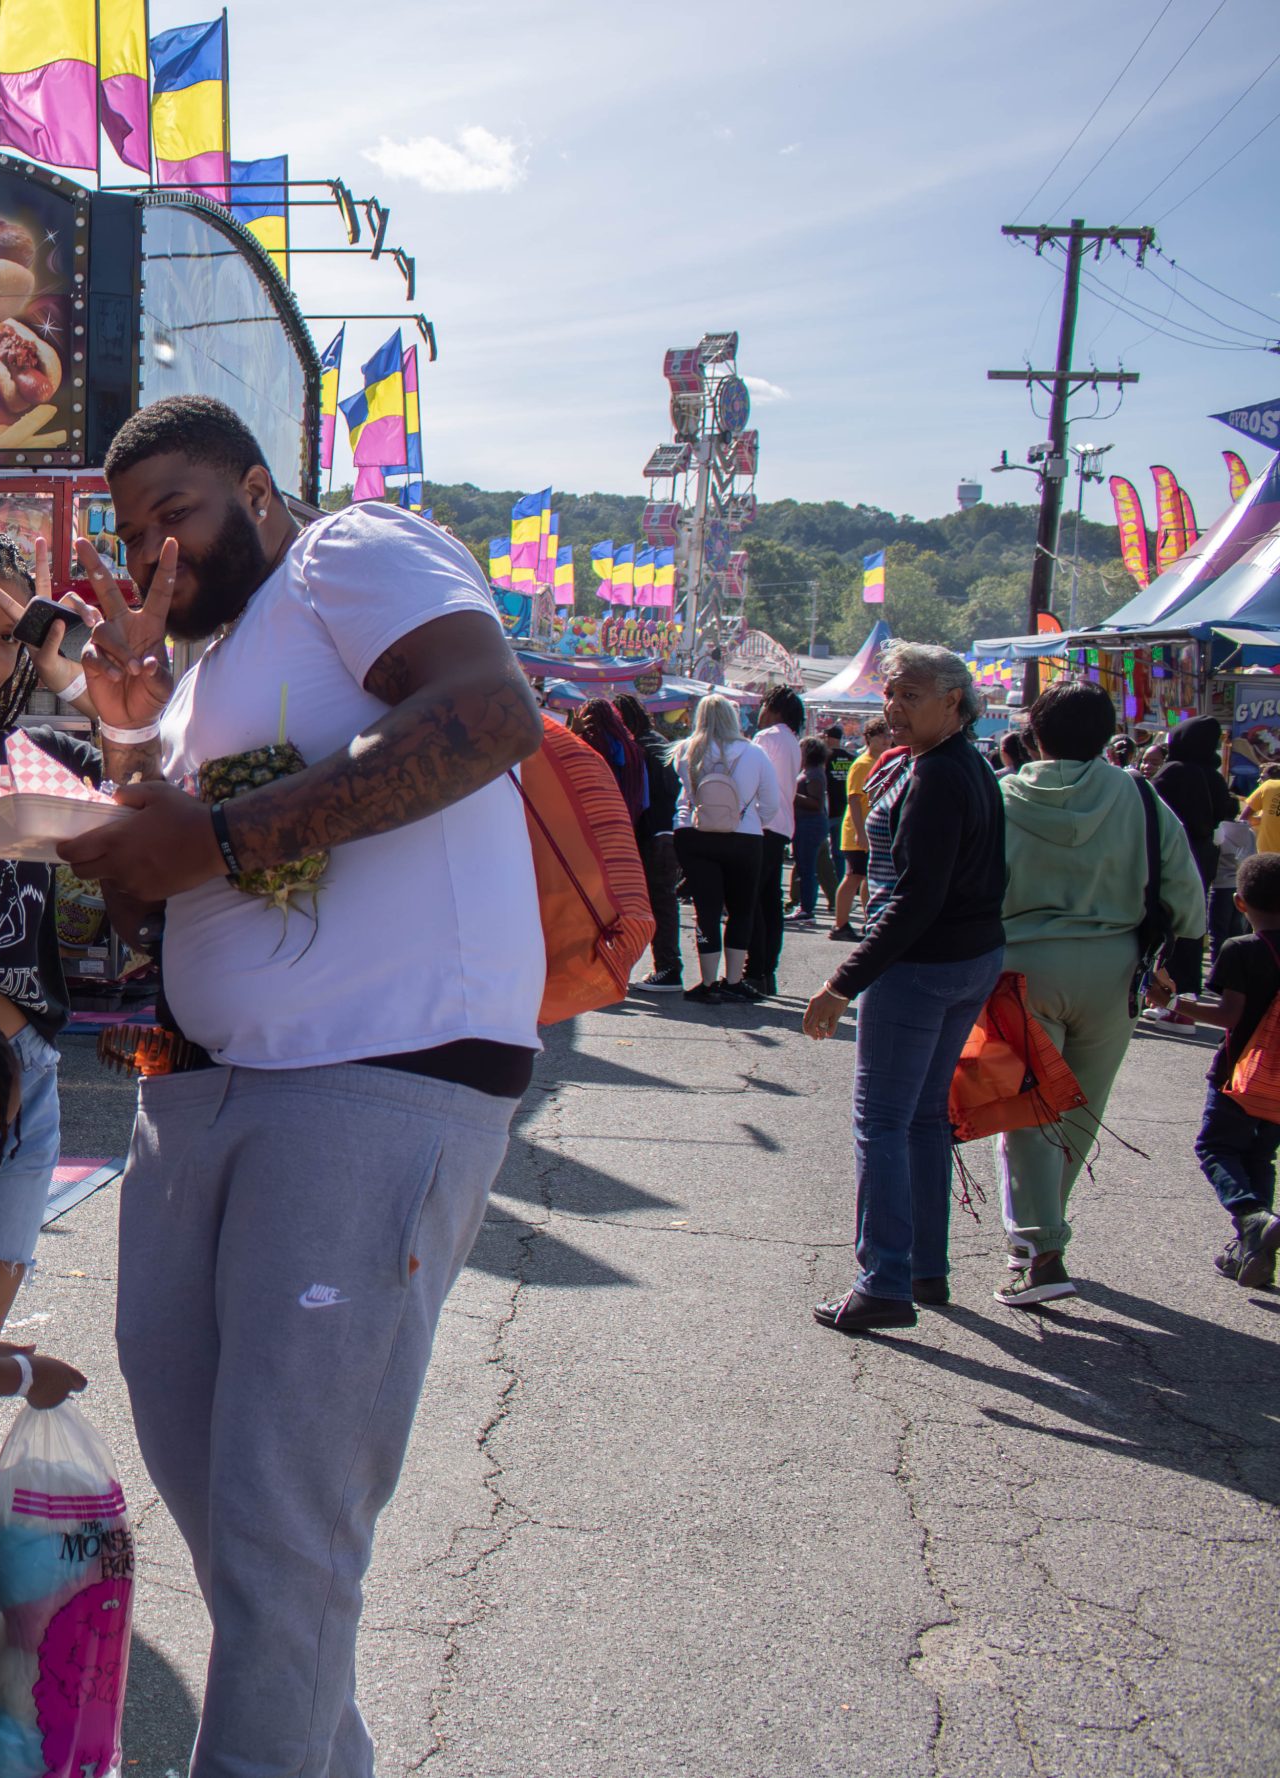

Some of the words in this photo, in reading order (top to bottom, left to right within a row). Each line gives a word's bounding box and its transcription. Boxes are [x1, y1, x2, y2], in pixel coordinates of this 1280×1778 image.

[1228, 410, 1280, 438] GYROS
[608, 626, 677, 653] BALLOONS
[307, 1283, 341, 1302] NIKE
